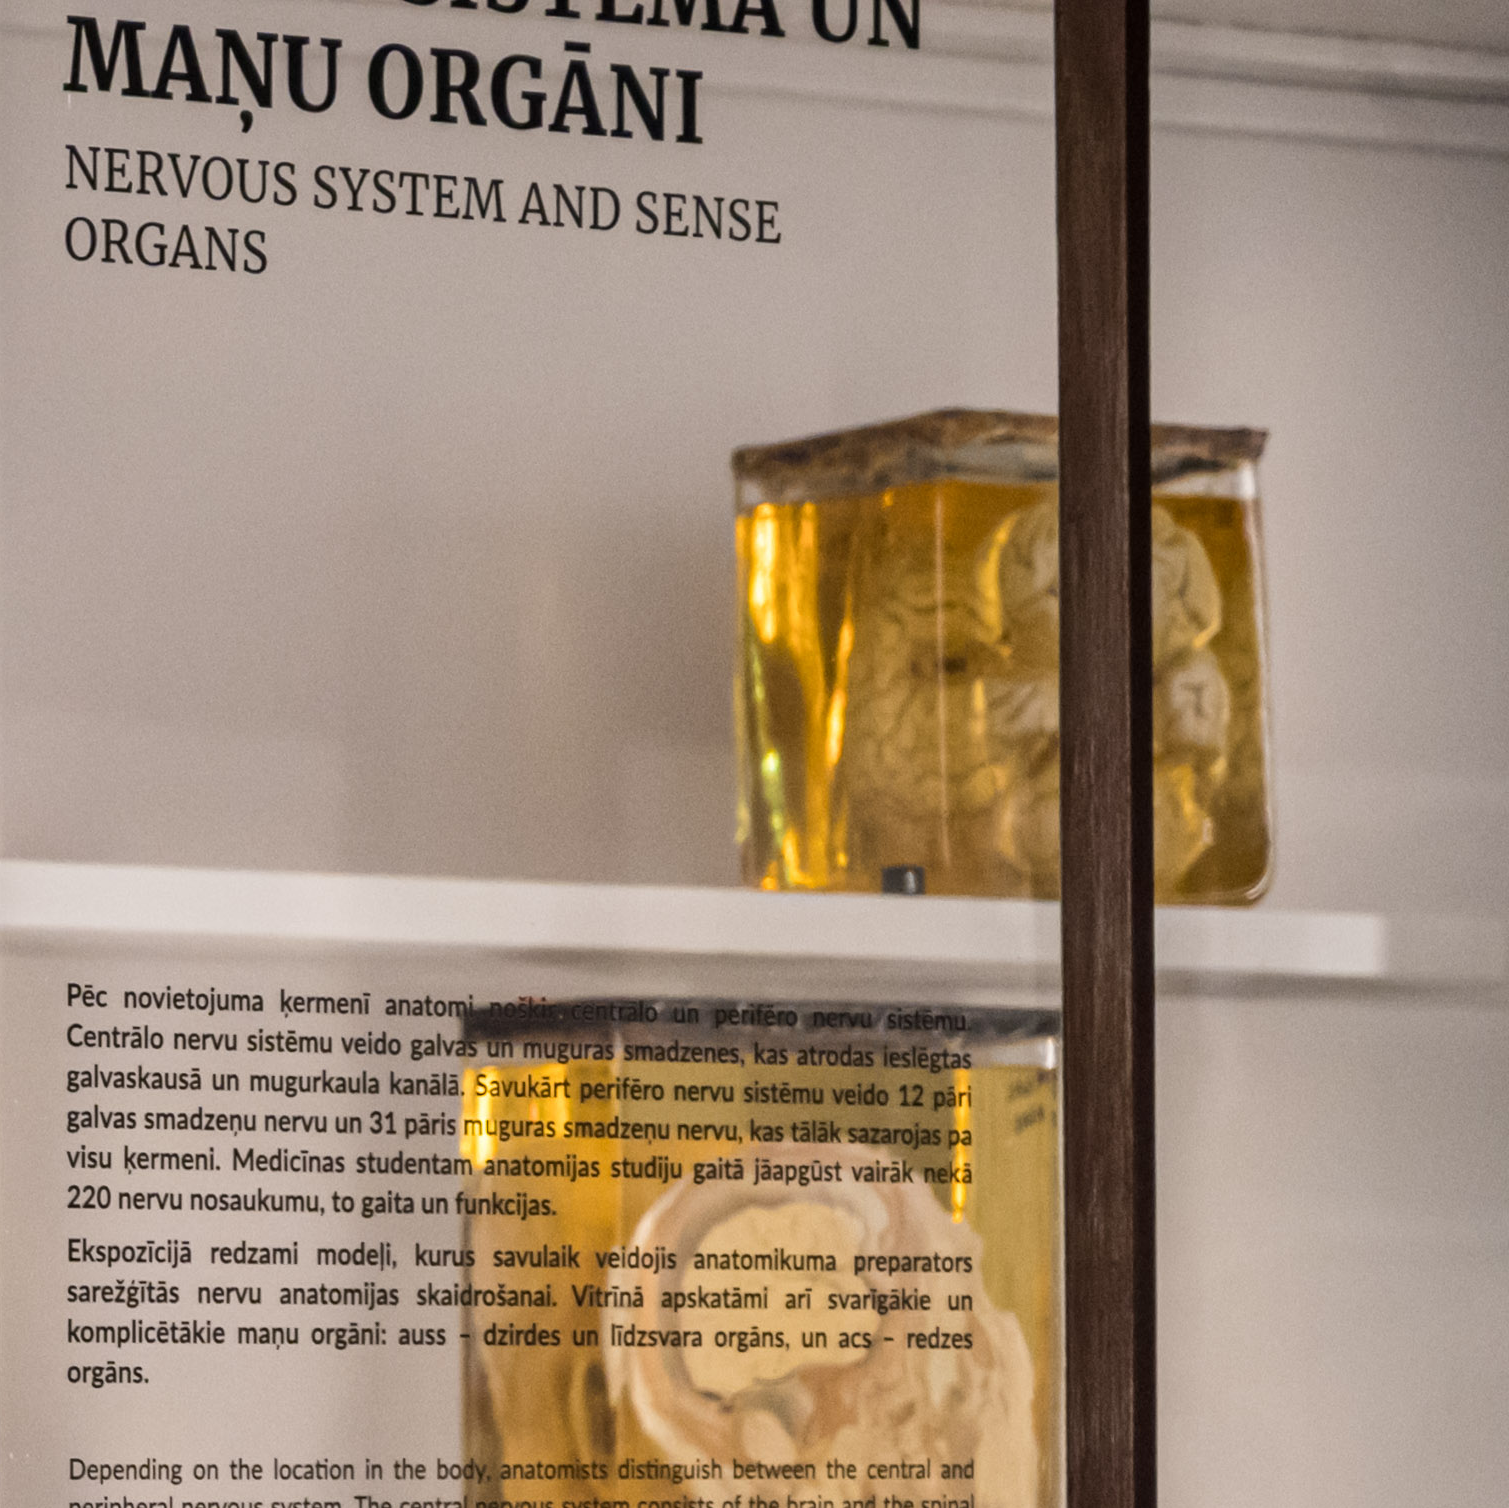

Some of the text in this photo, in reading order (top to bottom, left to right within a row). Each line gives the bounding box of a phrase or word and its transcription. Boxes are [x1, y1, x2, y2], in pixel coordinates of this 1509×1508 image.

[63, 16, 704, 146] MAŅU ORGĀNI
[66, 145, 782, 245] NERVOUS SYSTEM AND SENSE
[66, 217, 269, 276] ORGANS
[67, 982, 474, 1019] Pēc novietojuma ķermenī anatomi
[66, 1022, 478, 1062] Centrālo nervu sistēmu veido galvas
[66, 1063, 735, 1103] galvaskausā un mugurkaula kanālā. Savukārt nervu
[66, 1103, 973, 1150] galvas smadzeņu nervu un 31 pāris muguras nervu, pa
[66, 1144, 915, 1187] visu ķermeni. Medicīnas studentam anatomijas gaitā jāapgūst vairāk
[66, 1184, 449, 1219] 220 nervu nosaukumu, to gaita un
[67, 1237, 974, 1277] Ekspozīcijā redzami modeļi, kurus veidojis anatomikuma preparators
[66, 1278, 973, 1317] sarežģītās nervu anatomijas skaidrošanai. Vitrīnā apskatāmi arī svarīgākie un
[67, 1318, 974, 1354] komplicētākie maņu orgāni: auss dzirdes līdzsvara orgāns, un acs redzes
[66, 1360, 150, 1389] orgāns.
[69, 1457, 857, 1486] Depending on the location in the the
